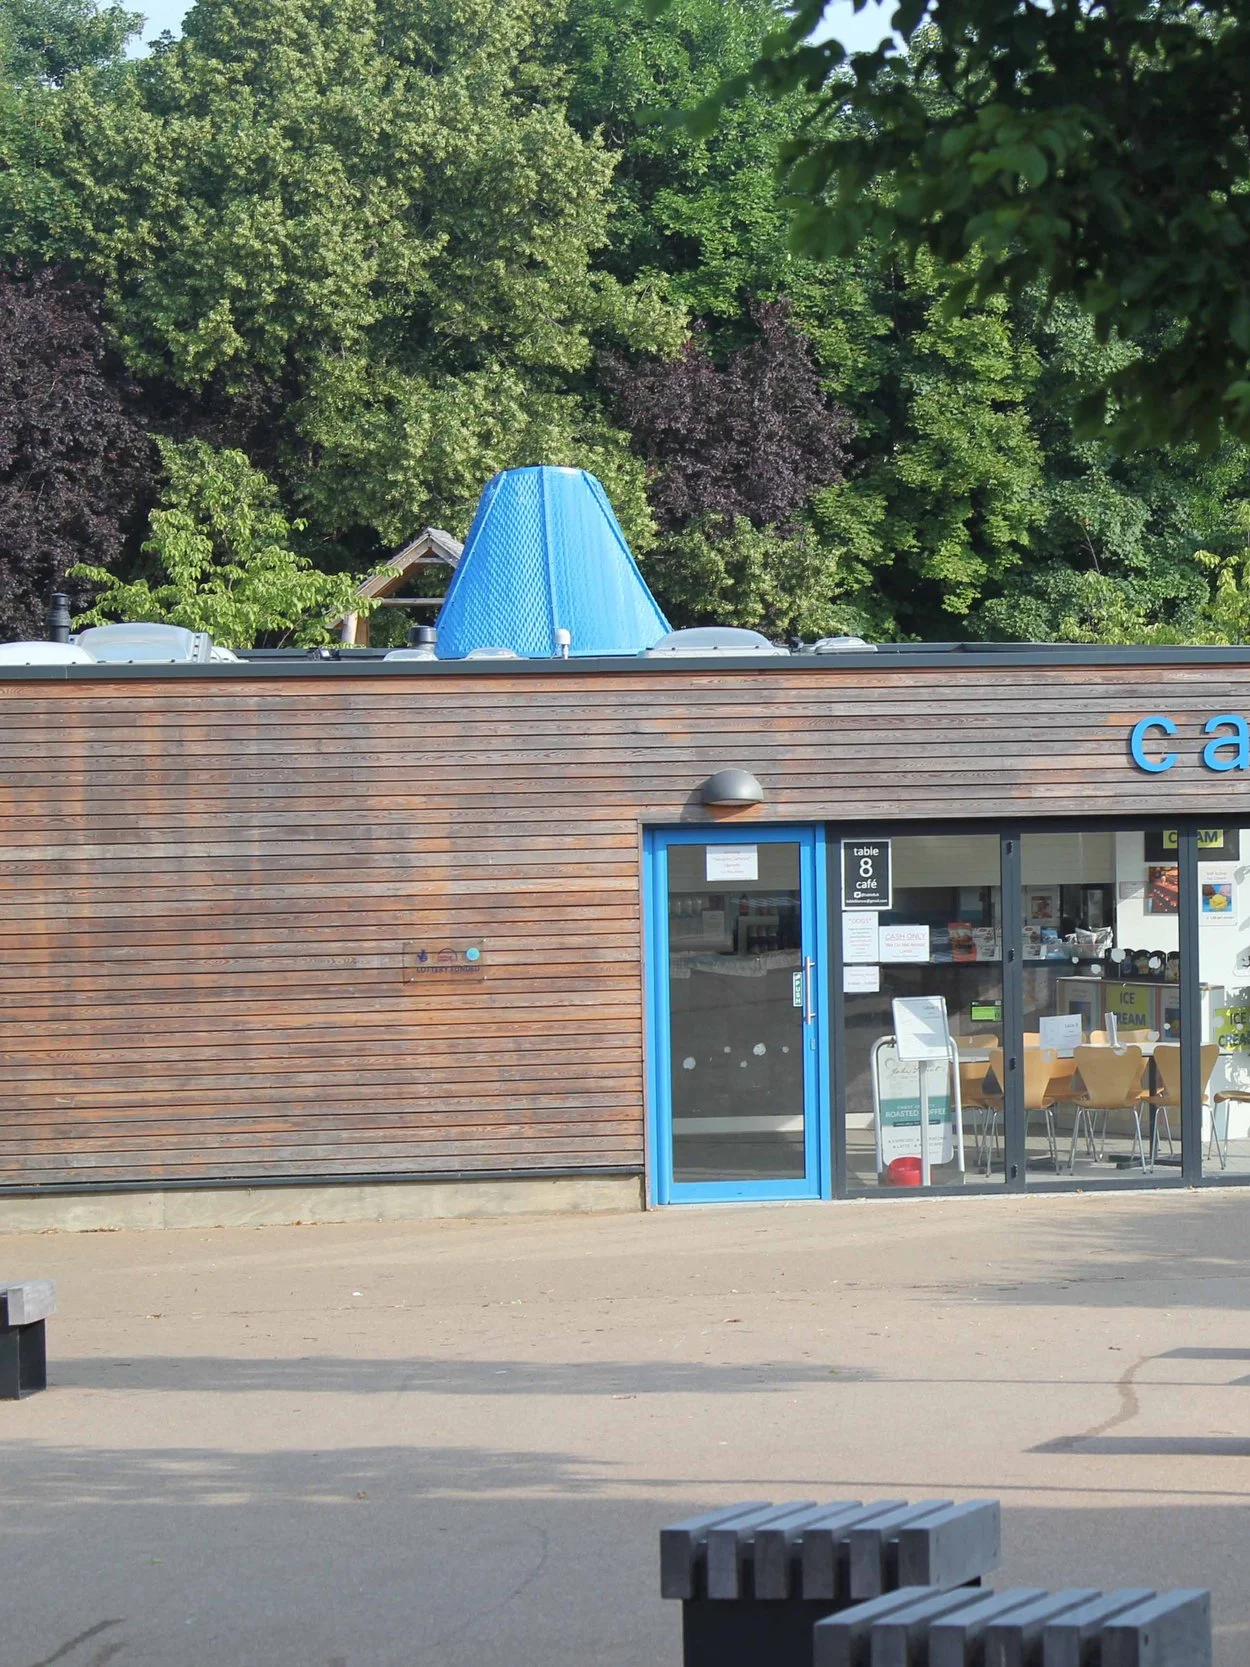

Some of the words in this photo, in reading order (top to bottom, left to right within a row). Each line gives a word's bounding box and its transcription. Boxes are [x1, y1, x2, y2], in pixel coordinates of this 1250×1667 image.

[1168, 830, 1218, 843] CAM
[853, 846, 880, 856] table
[859, 857, 873, 877] 8
[855, 878, 878, 889] café
[906, 932, 926, 940] ONLY
[450, 965, 480, 973] FUNDED
[1119, 991, 1136, 1005] ICE
[1114, 1012, 1146, 1027] REAM
[1229, 1012, 1247, 1026] ICE
[1218, 1032, 1249, 1048] CREA
[885, 1109, 919, 1118] ROASTED
[922, 1108, 946, 1116] OFFEE
